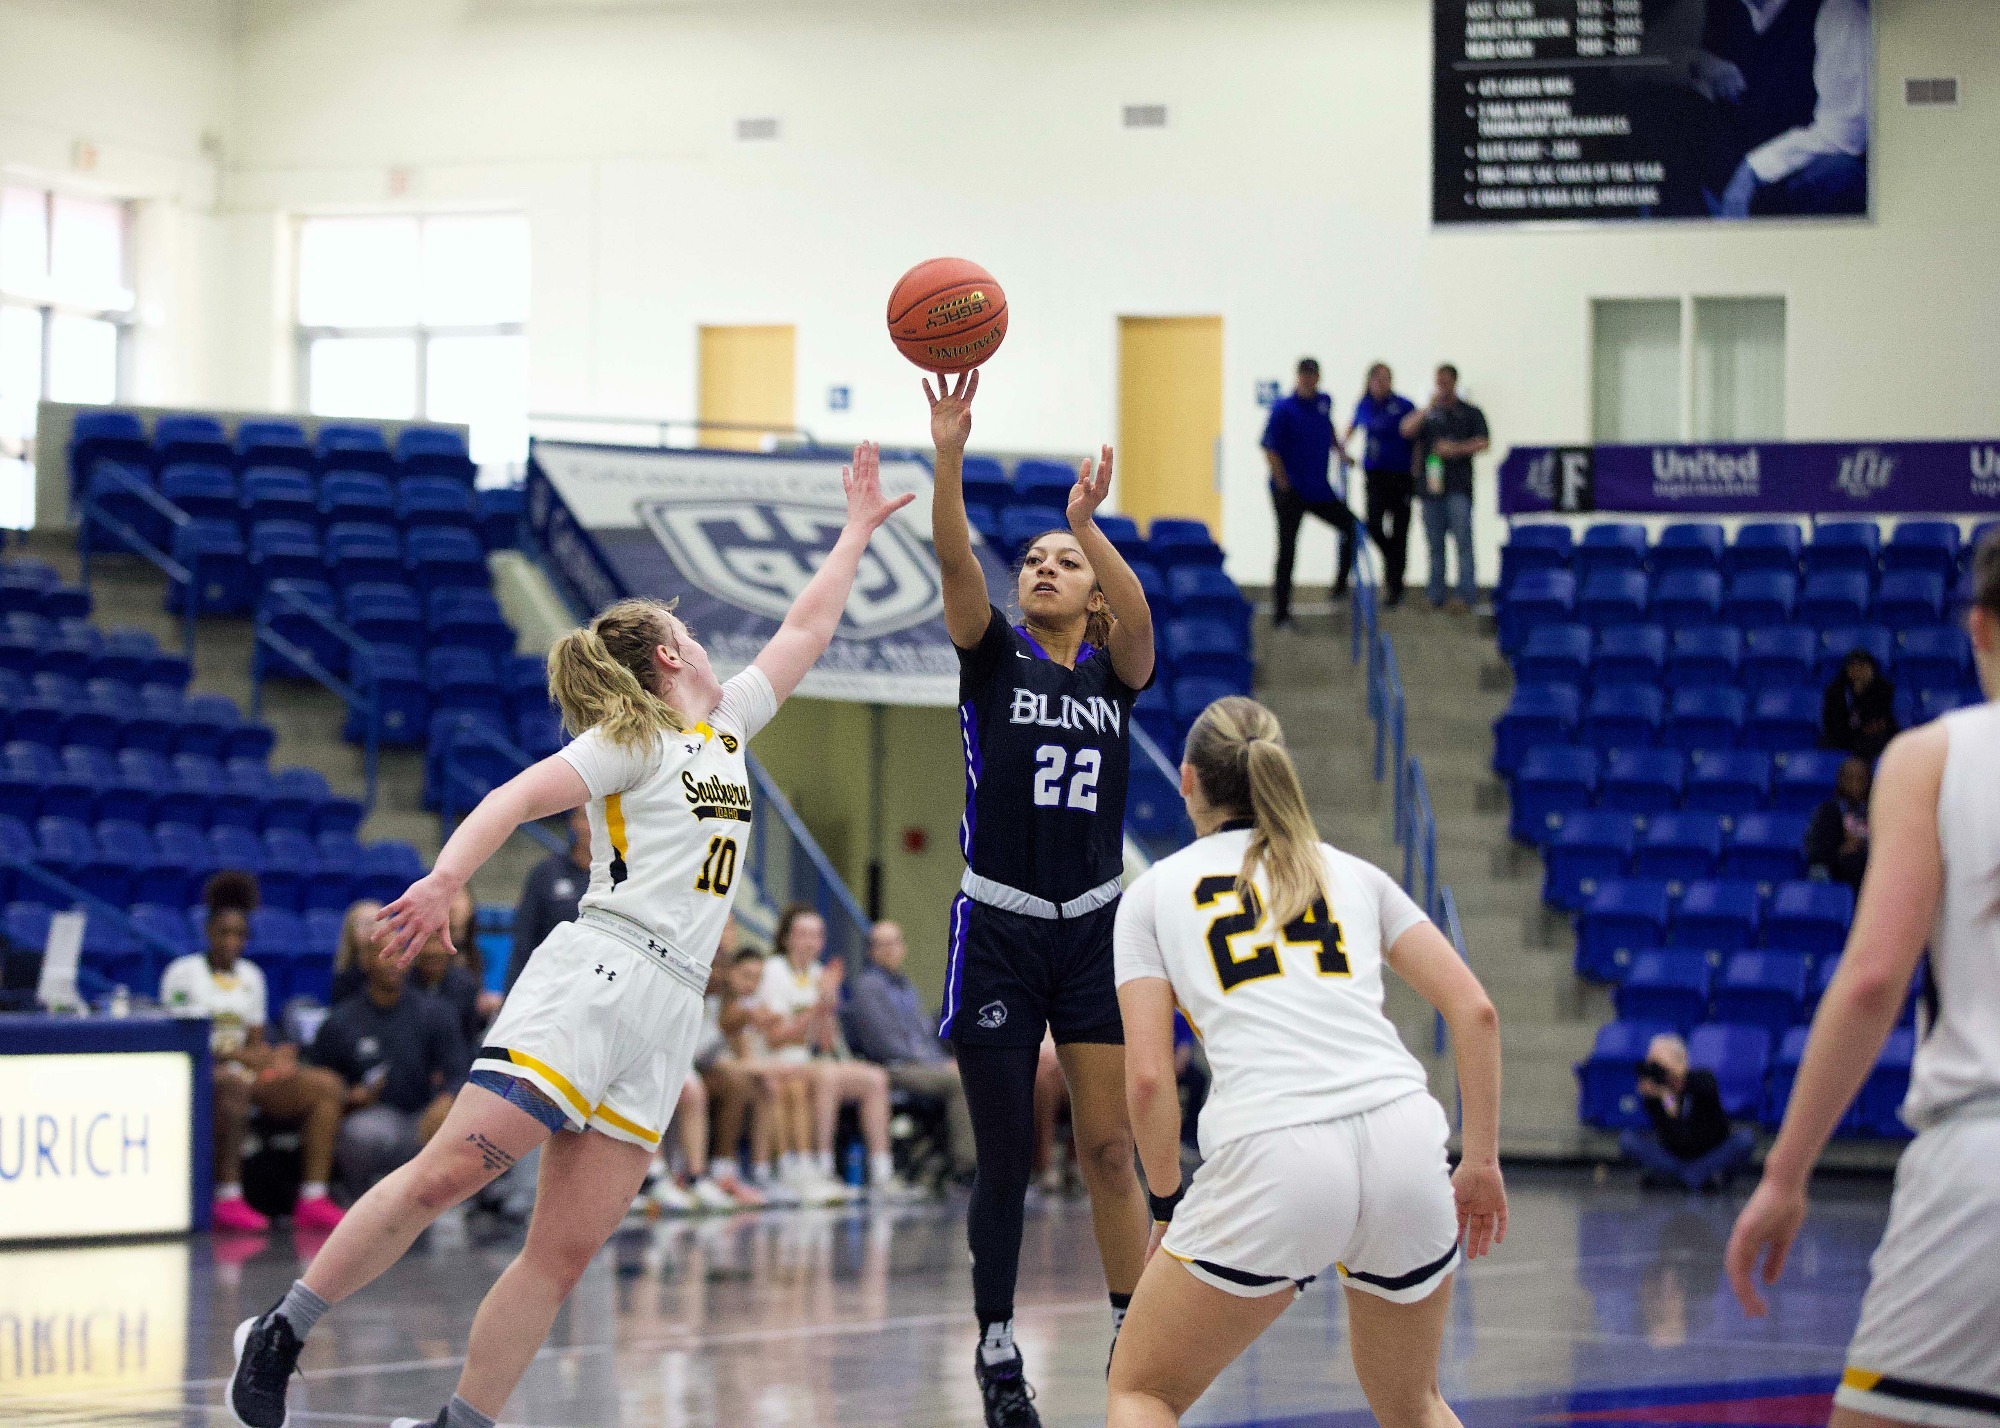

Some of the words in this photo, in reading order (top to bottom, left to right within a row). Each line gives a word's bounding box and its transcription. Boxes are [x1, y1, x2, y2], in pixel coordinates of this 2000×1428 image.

[926, 298, 993, 330] LEGACY
[928, 322, 1001, 359] SPALDING
[1561, 450, 1588, 508] F
[1653, 448, 1760, 481] United
[1009, 687, 1121, 738] BLINN
[682, 770, 750, 807] Southern
[1034, 744, 1102, 813] 22
[714, 806, 739, 820] IDAHO
[694, 835, 737, 898] 10
[1192, 874, 1352, 996] 24
